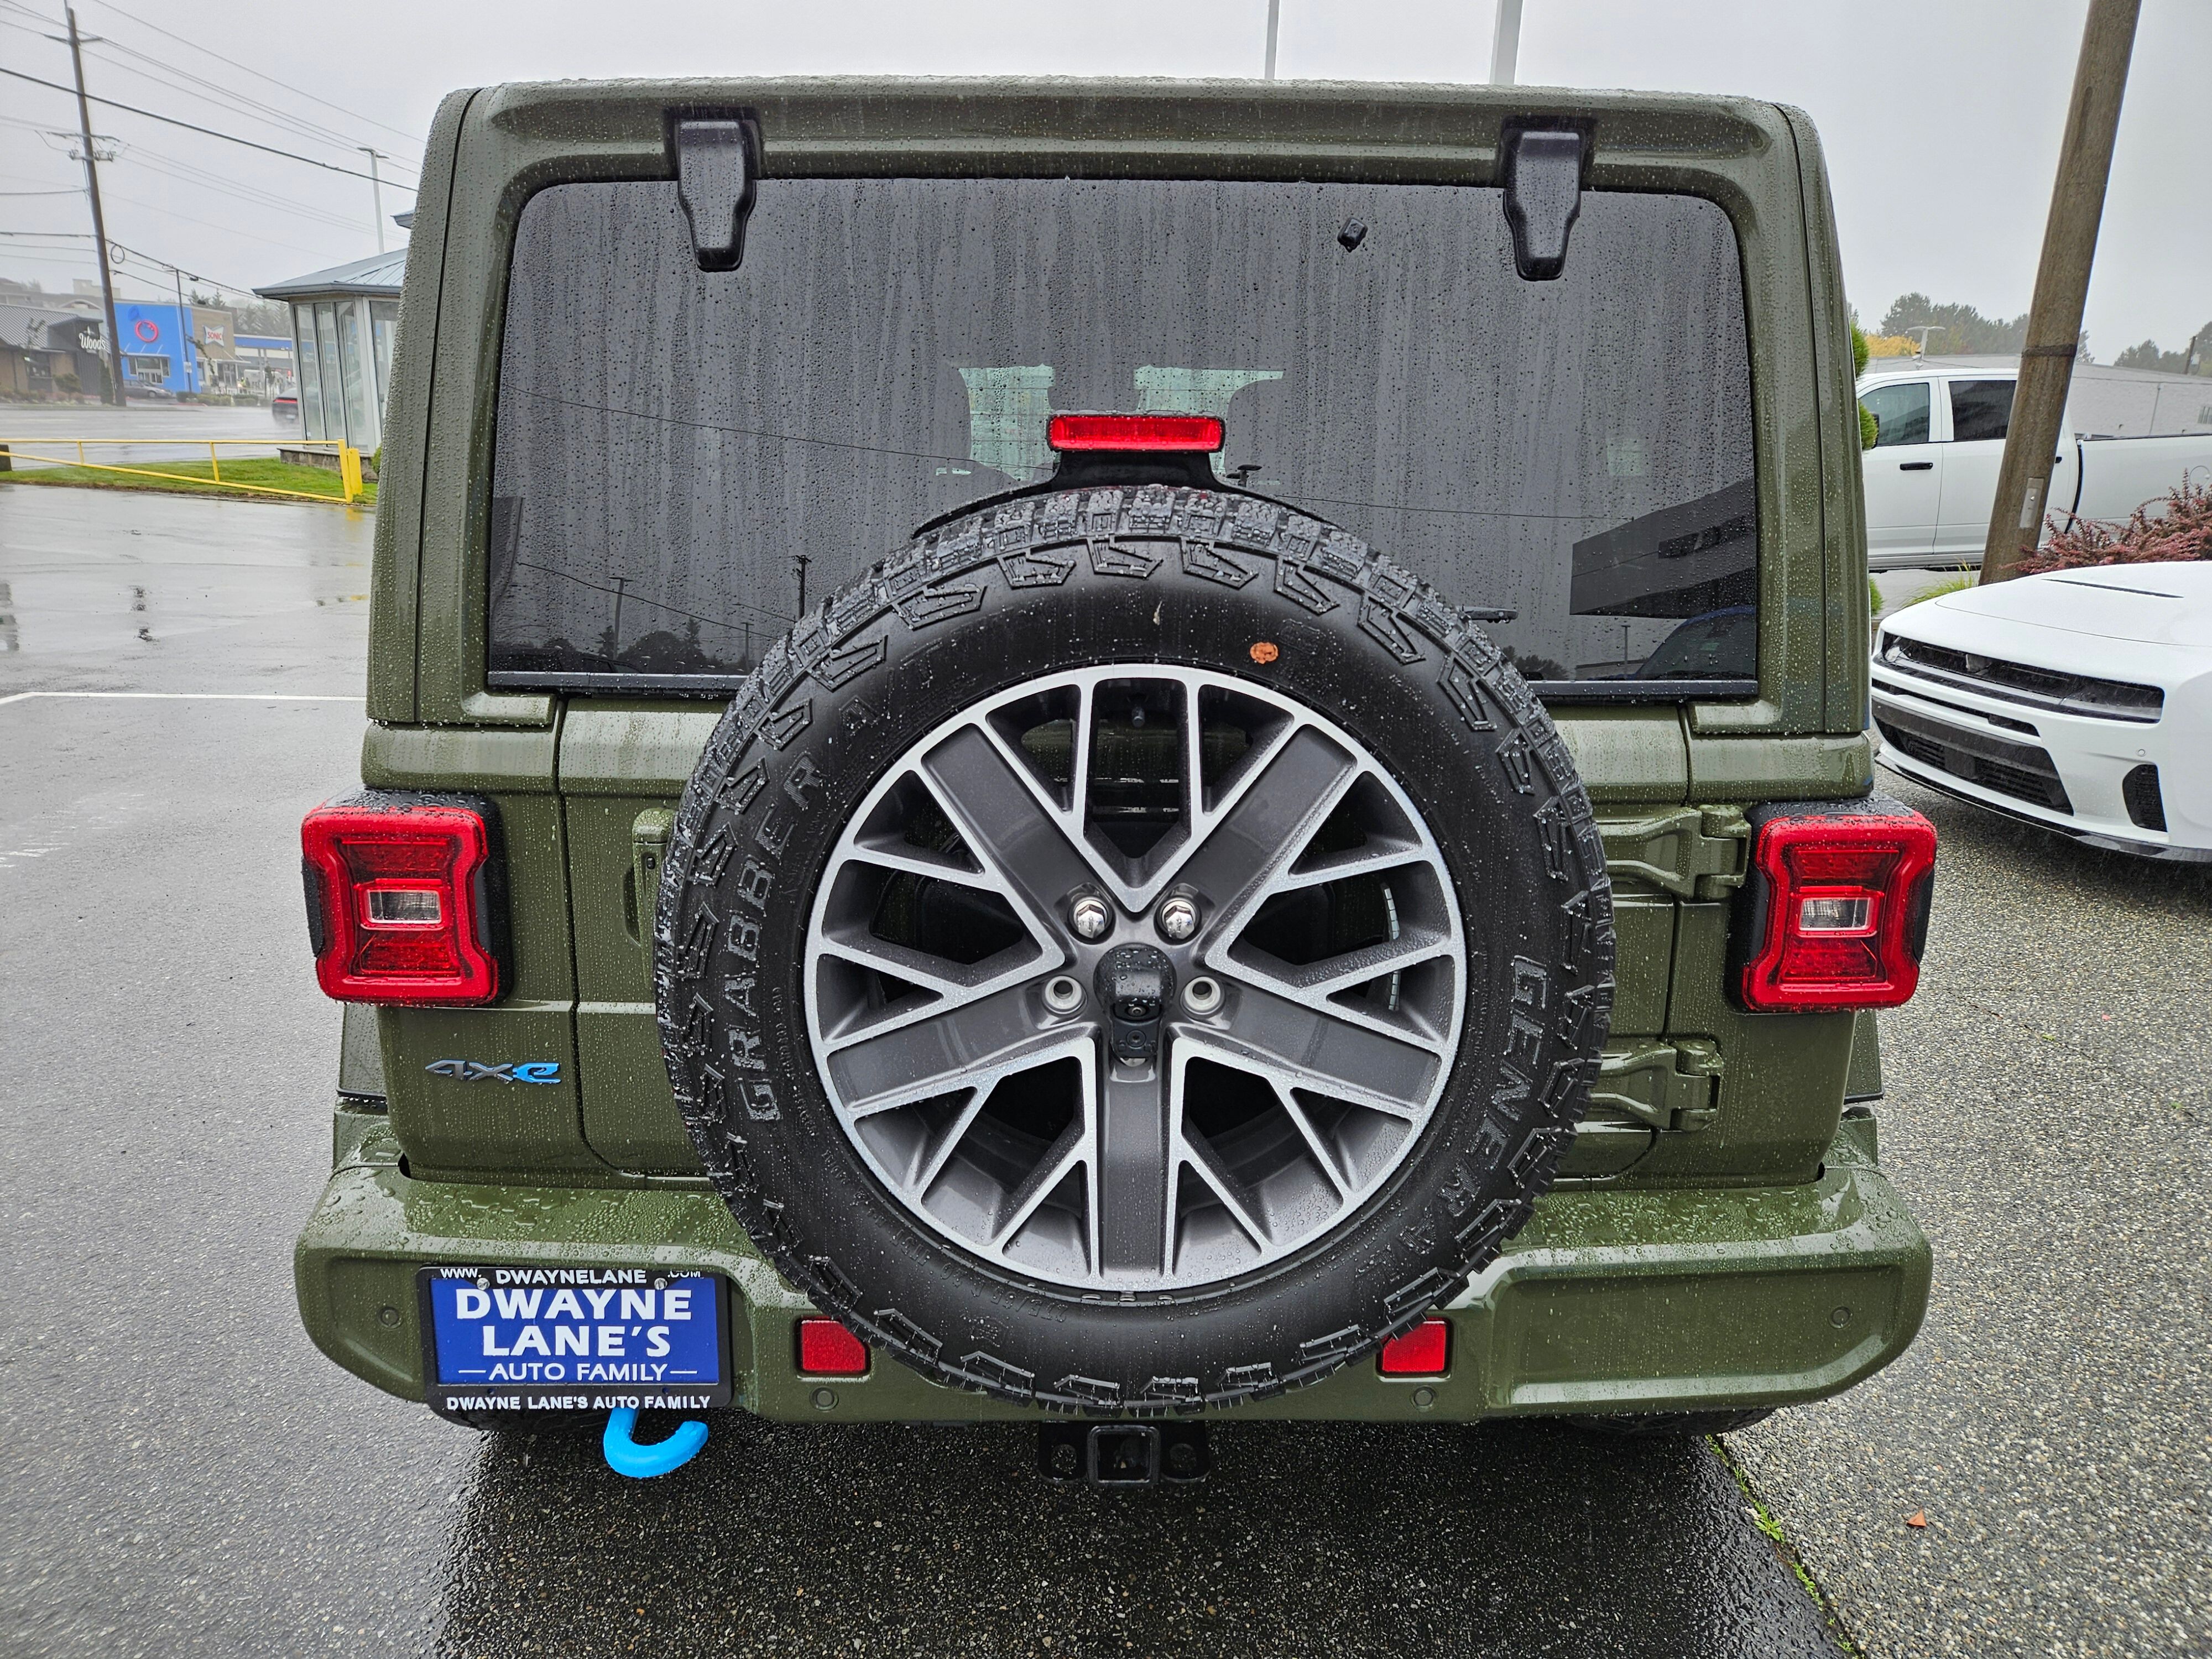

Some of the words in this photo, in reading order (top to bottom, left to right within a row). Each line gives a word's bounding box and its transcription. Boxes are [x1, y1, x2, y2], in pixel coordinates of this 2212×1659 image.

[207, 331, 222, 340] SONIC
[722, 750, 828, 1123] GRABBER
[1355, 954, 1548, 1283] GENERAL
[440, 1268, 482, 1279] WWW.
[495, 1270, 647, 1285] DWAYNELANE
[456, 1289, 692, 1321] DWAYNE
[483, 1325, 671, 1357] LANE'S
[488, 1363, 565, 1381] AUTO
[577, 1363, 668, 1381] FAMILY
[446, 1397, 520, 1411] DWAYNE
[528, 1396, 588, 1410] LANE'S
[593, 1396, 640, 1409] AUTO
[644, 1396, 710, 1410] FAMILY
